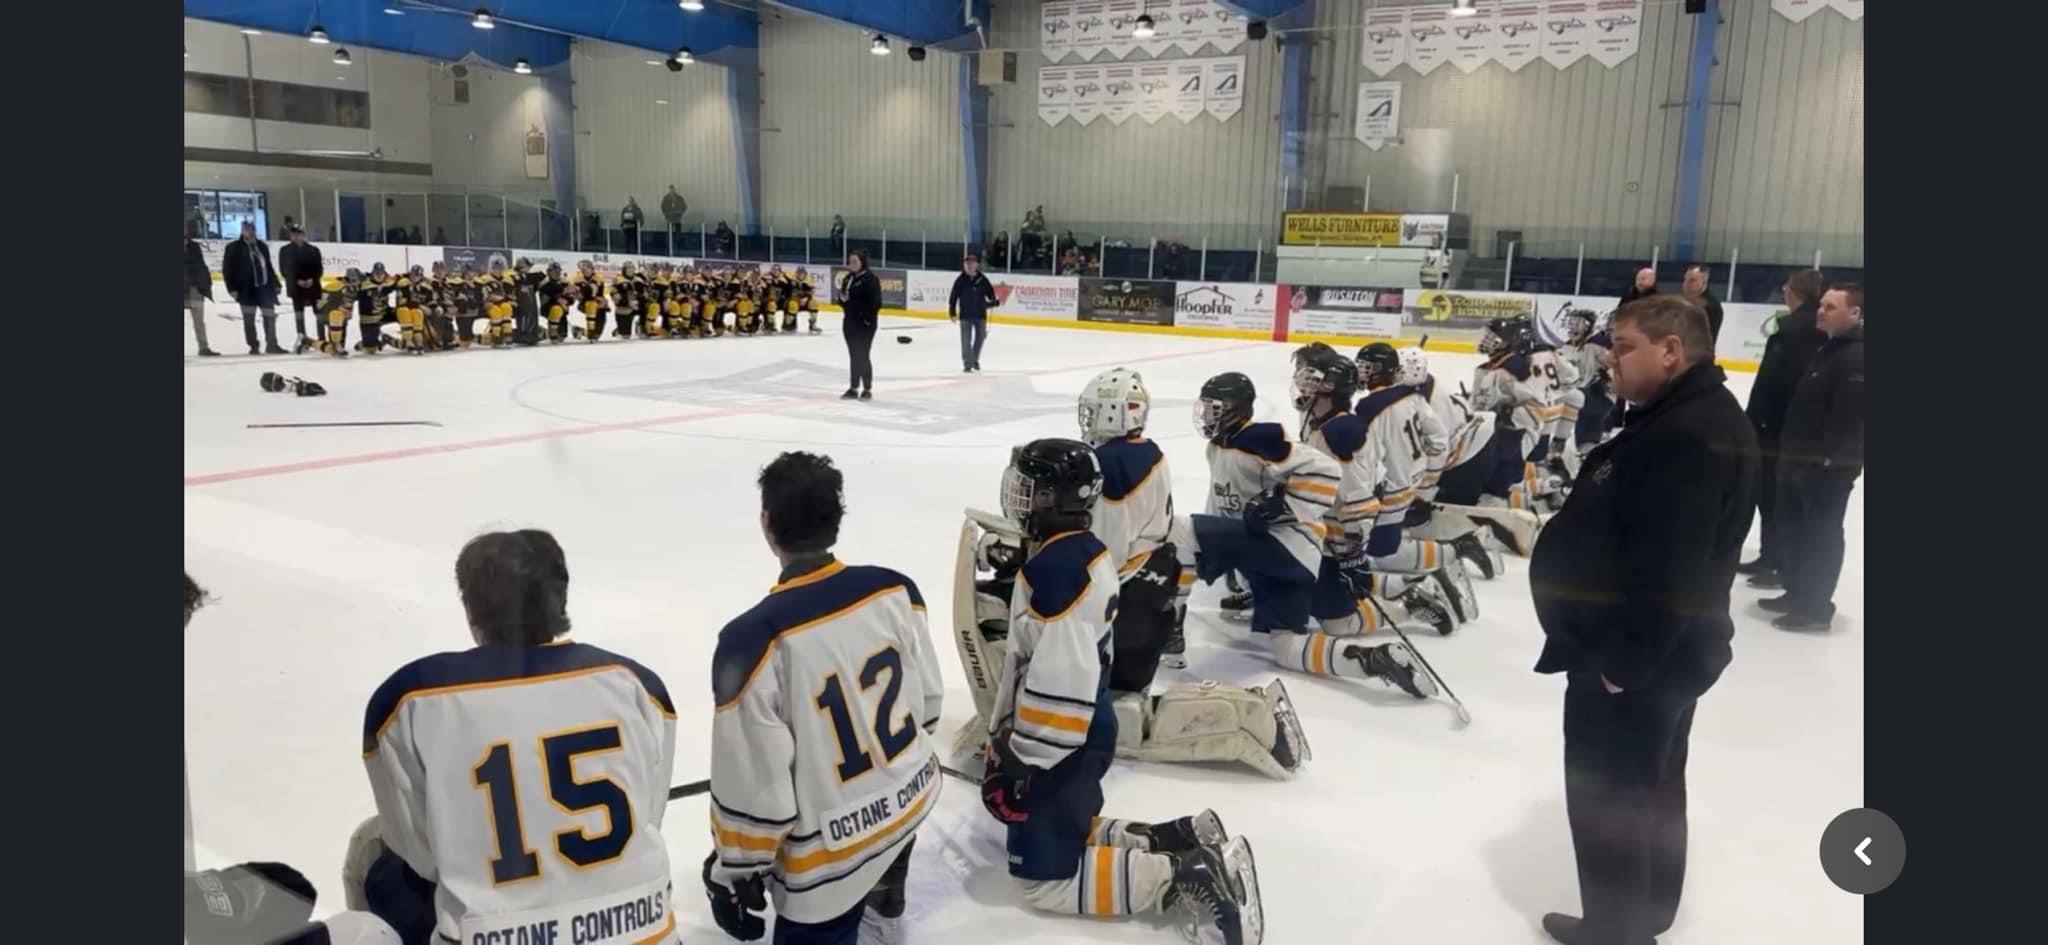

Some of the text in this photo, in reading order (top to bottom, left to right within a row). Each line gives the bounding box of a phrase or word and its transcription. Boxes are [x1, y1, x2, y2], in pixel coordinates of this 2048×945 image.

[1288, 217, 1399, 233] WELLS FURNITURE
[1092, 294, 1127, 308] GARY
[813, 641, 920, 785] 12
[470, 721, 635, 887] 15
[829, 797, 892, 842] OCTANE
[570, 891, 664, 945] CONTROLS
